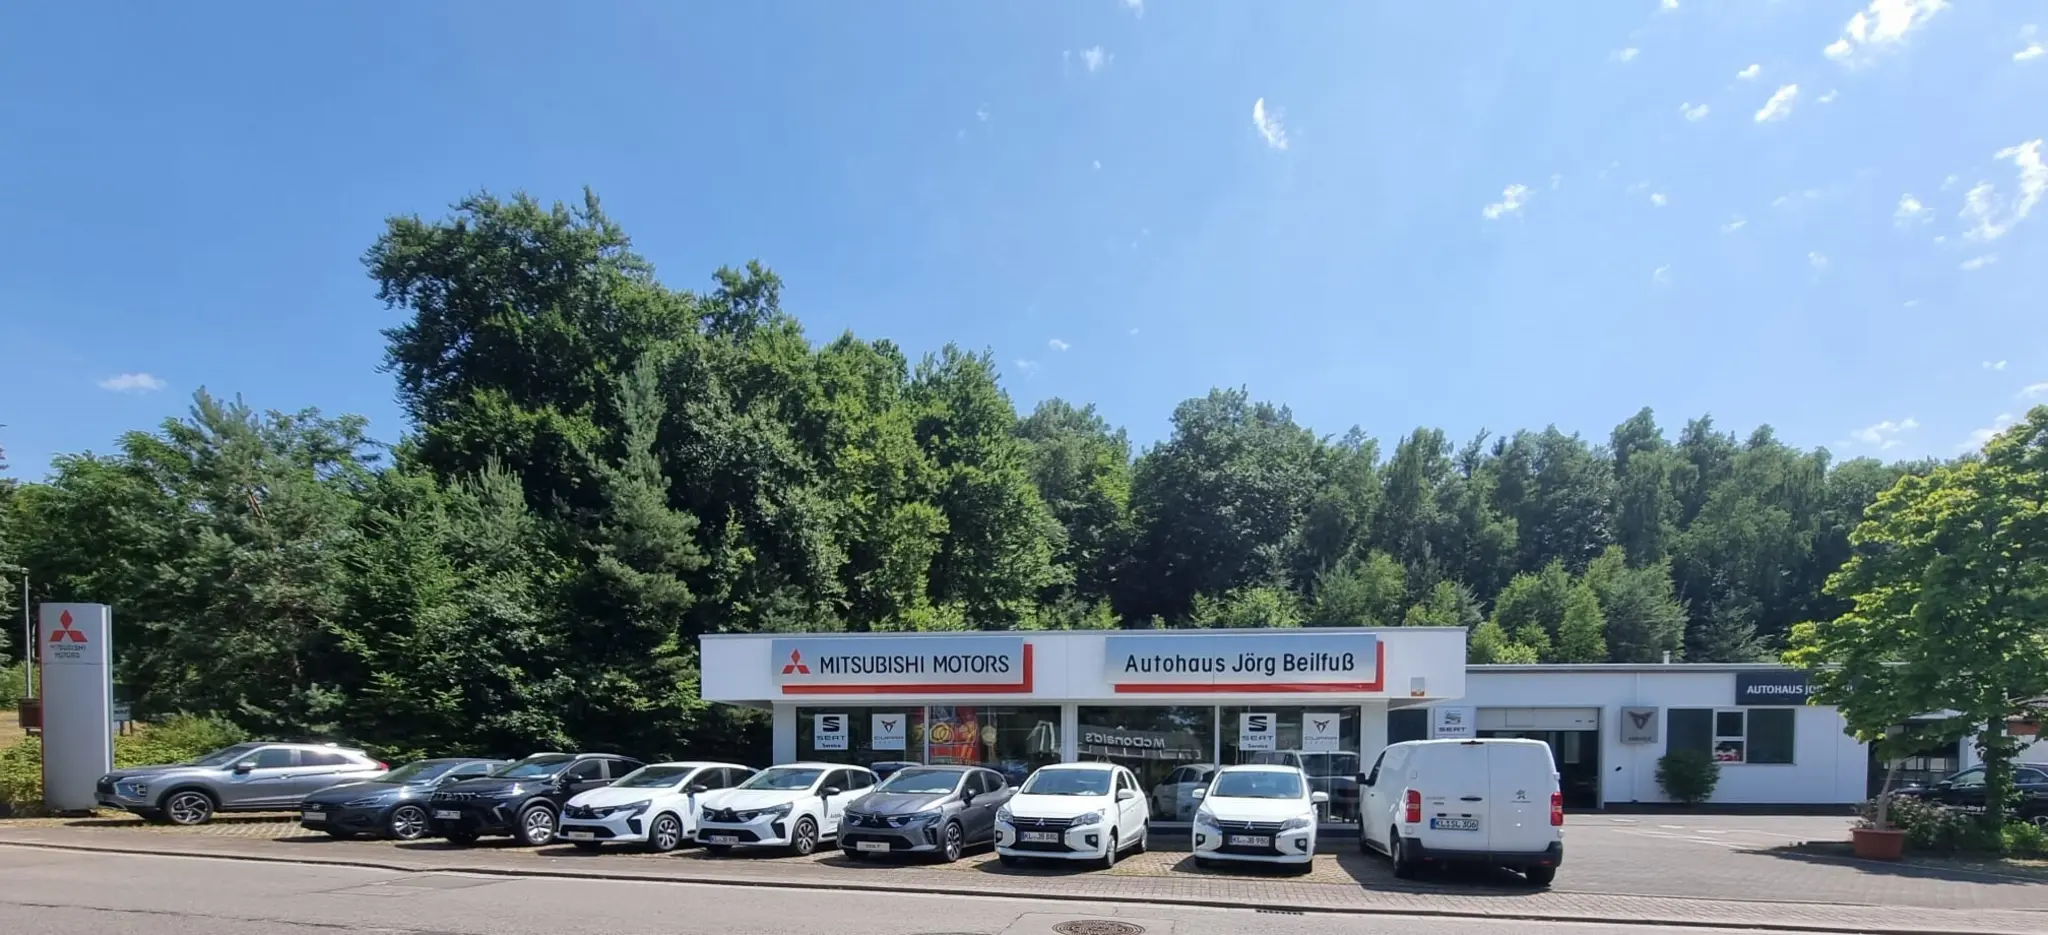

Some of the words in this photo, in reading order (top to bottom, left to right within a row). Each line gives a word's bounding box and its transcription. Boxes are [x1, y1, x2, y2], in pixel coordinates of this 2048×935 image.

[819, 655, 925, 674] MITSUBISHI
[933, 655, 1010, 673] MOTORS
[1124, 653, 1225, 673] Autohaus
[1231, 653, 1276, 676] Jörg
[1282, 652, 1355, 673] Beilfuß
[1747, 684, 1802, 694] AUTOHAUS
